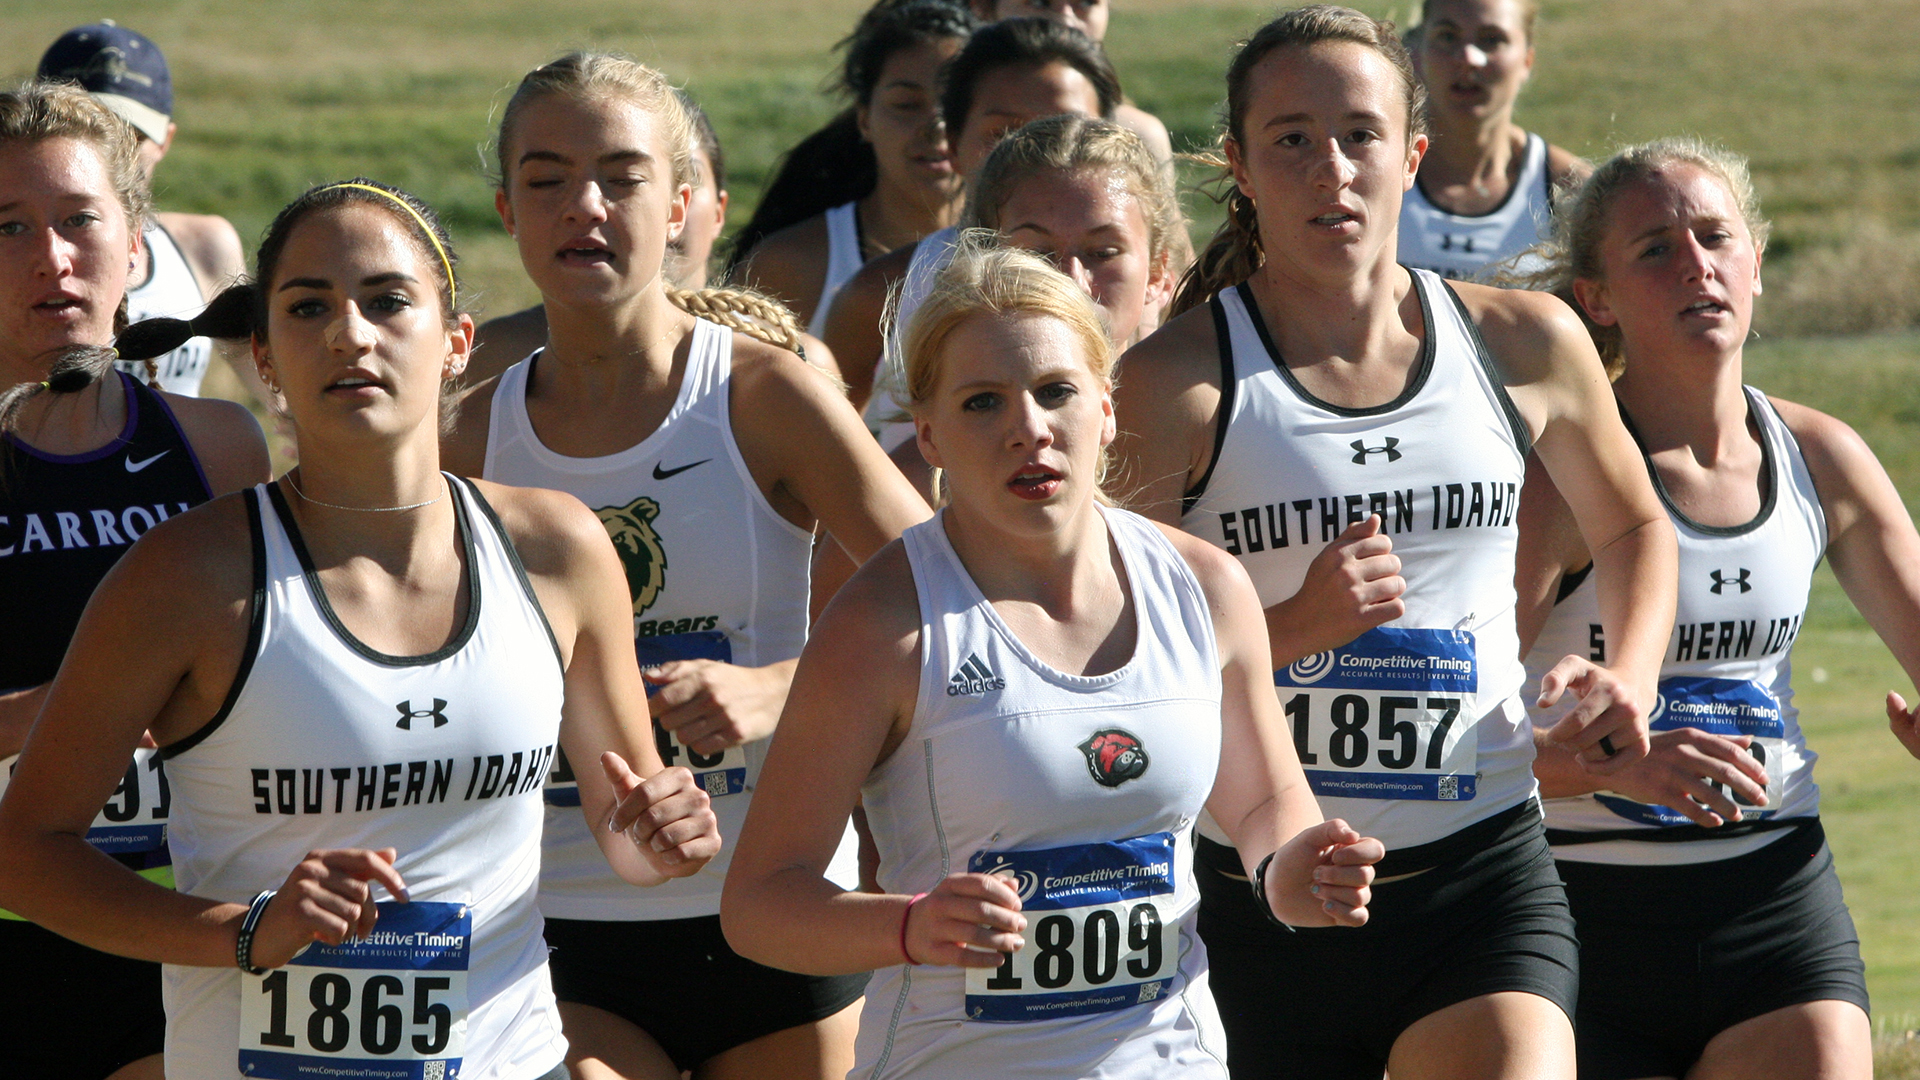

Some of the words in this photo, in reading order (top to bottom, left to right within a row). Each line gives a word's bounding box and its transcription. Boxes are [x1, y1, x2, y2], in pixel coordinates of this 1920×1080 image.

[1219, 489, 1414, 555] SOUTHERN
[1432, 482, 1516, 530] IDAHO
[0, 503, 189, 556] CARRO
[637, 615, 719, 639] Bears
[1340, 670, 1383, 678] ACCURATE
[946, 676, 1006, 697] adidas
[1669, 715, 1703, 724] ACCURATE
[1706, 717, 1733, 725] RESULTS
[1285, 693, 1461, 770] 1857
[251, 758, 454, 815] SOUTHERN
[464, 744, 553, 801] IDAHO
[1321, 780, 1424, 791] www.CompetitiveTiming.com
[1087, 883, 1120, 894] RESULTS
[1152, 876, 1170, 885] TIME
[320, 947, 366, 957] ACCURATE
[370, 949, 408, 957] RESULTS
[415, 950, 441, 958] EVERY
[443, 950, 462, 958] TIME
[986, 902, 1163, 990] 1809
[260, 970, 452, 1055] 1865
[1025, 994, 1126, 1011] www.CompetitiveTiming.com
[298, 1065, 408, 1078] www.CompetitiveTiming.com
